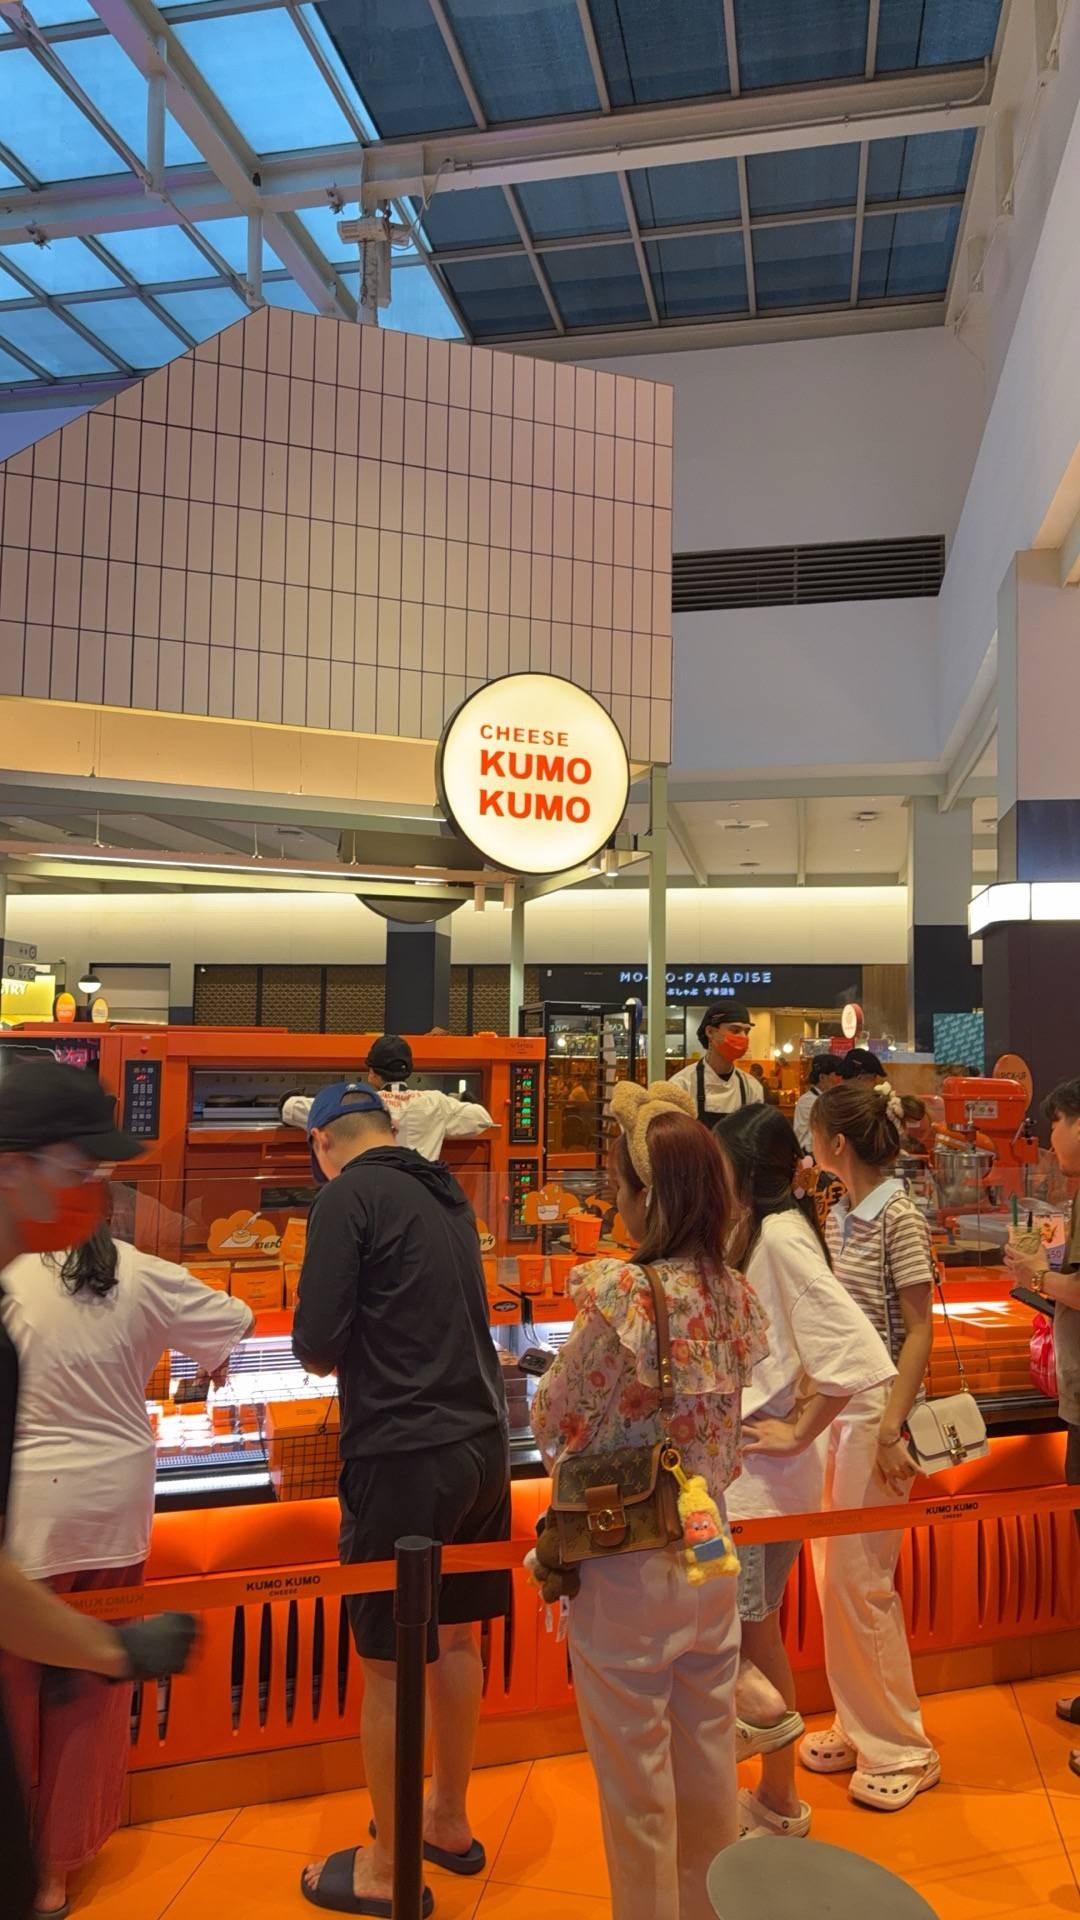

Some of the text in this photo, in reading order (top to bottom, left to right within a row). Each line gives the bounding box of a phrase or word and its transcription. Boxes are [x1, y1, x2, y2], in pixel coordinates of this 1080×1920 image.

[480, 725, 569, 747] CHEESE
[480, 749, 592, 785] KUMO
[479, 789, 591, 823] KUMO
[619, 971, 772, 984] MO-O-PARADISE
[926, 1502, 979, 1515] KUMO KUMO
[246, 1575, 321, 1591] KUMO KUMO
